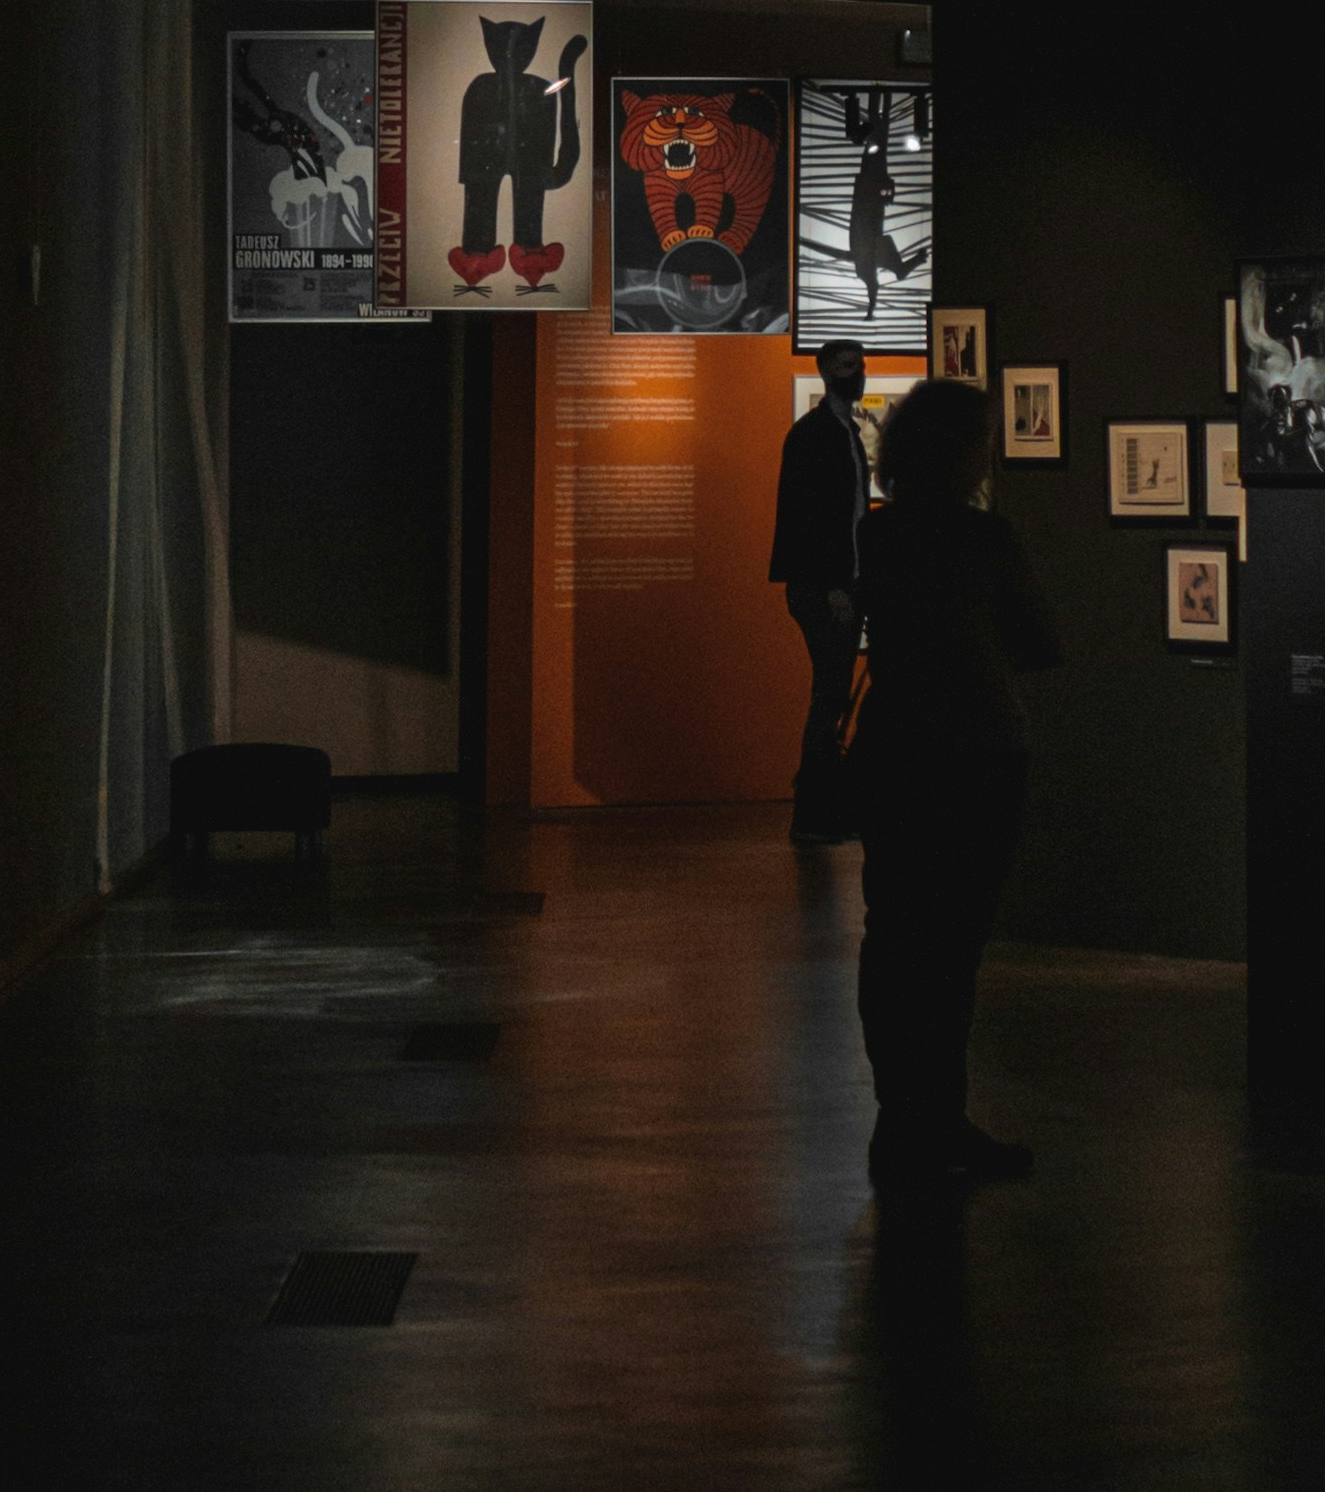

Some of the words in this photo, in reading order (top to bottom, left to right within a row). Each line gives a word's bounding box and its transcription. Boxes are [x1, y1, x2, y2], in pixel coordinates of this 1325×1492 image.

[379, 2, 403, 164] NIETOLERANCJI
[235, 235, 279, 249] TADEUSZ
[235, 250, 315, 268] GRONOWSKI
[378, 207, 402, 306] PRZECIW
